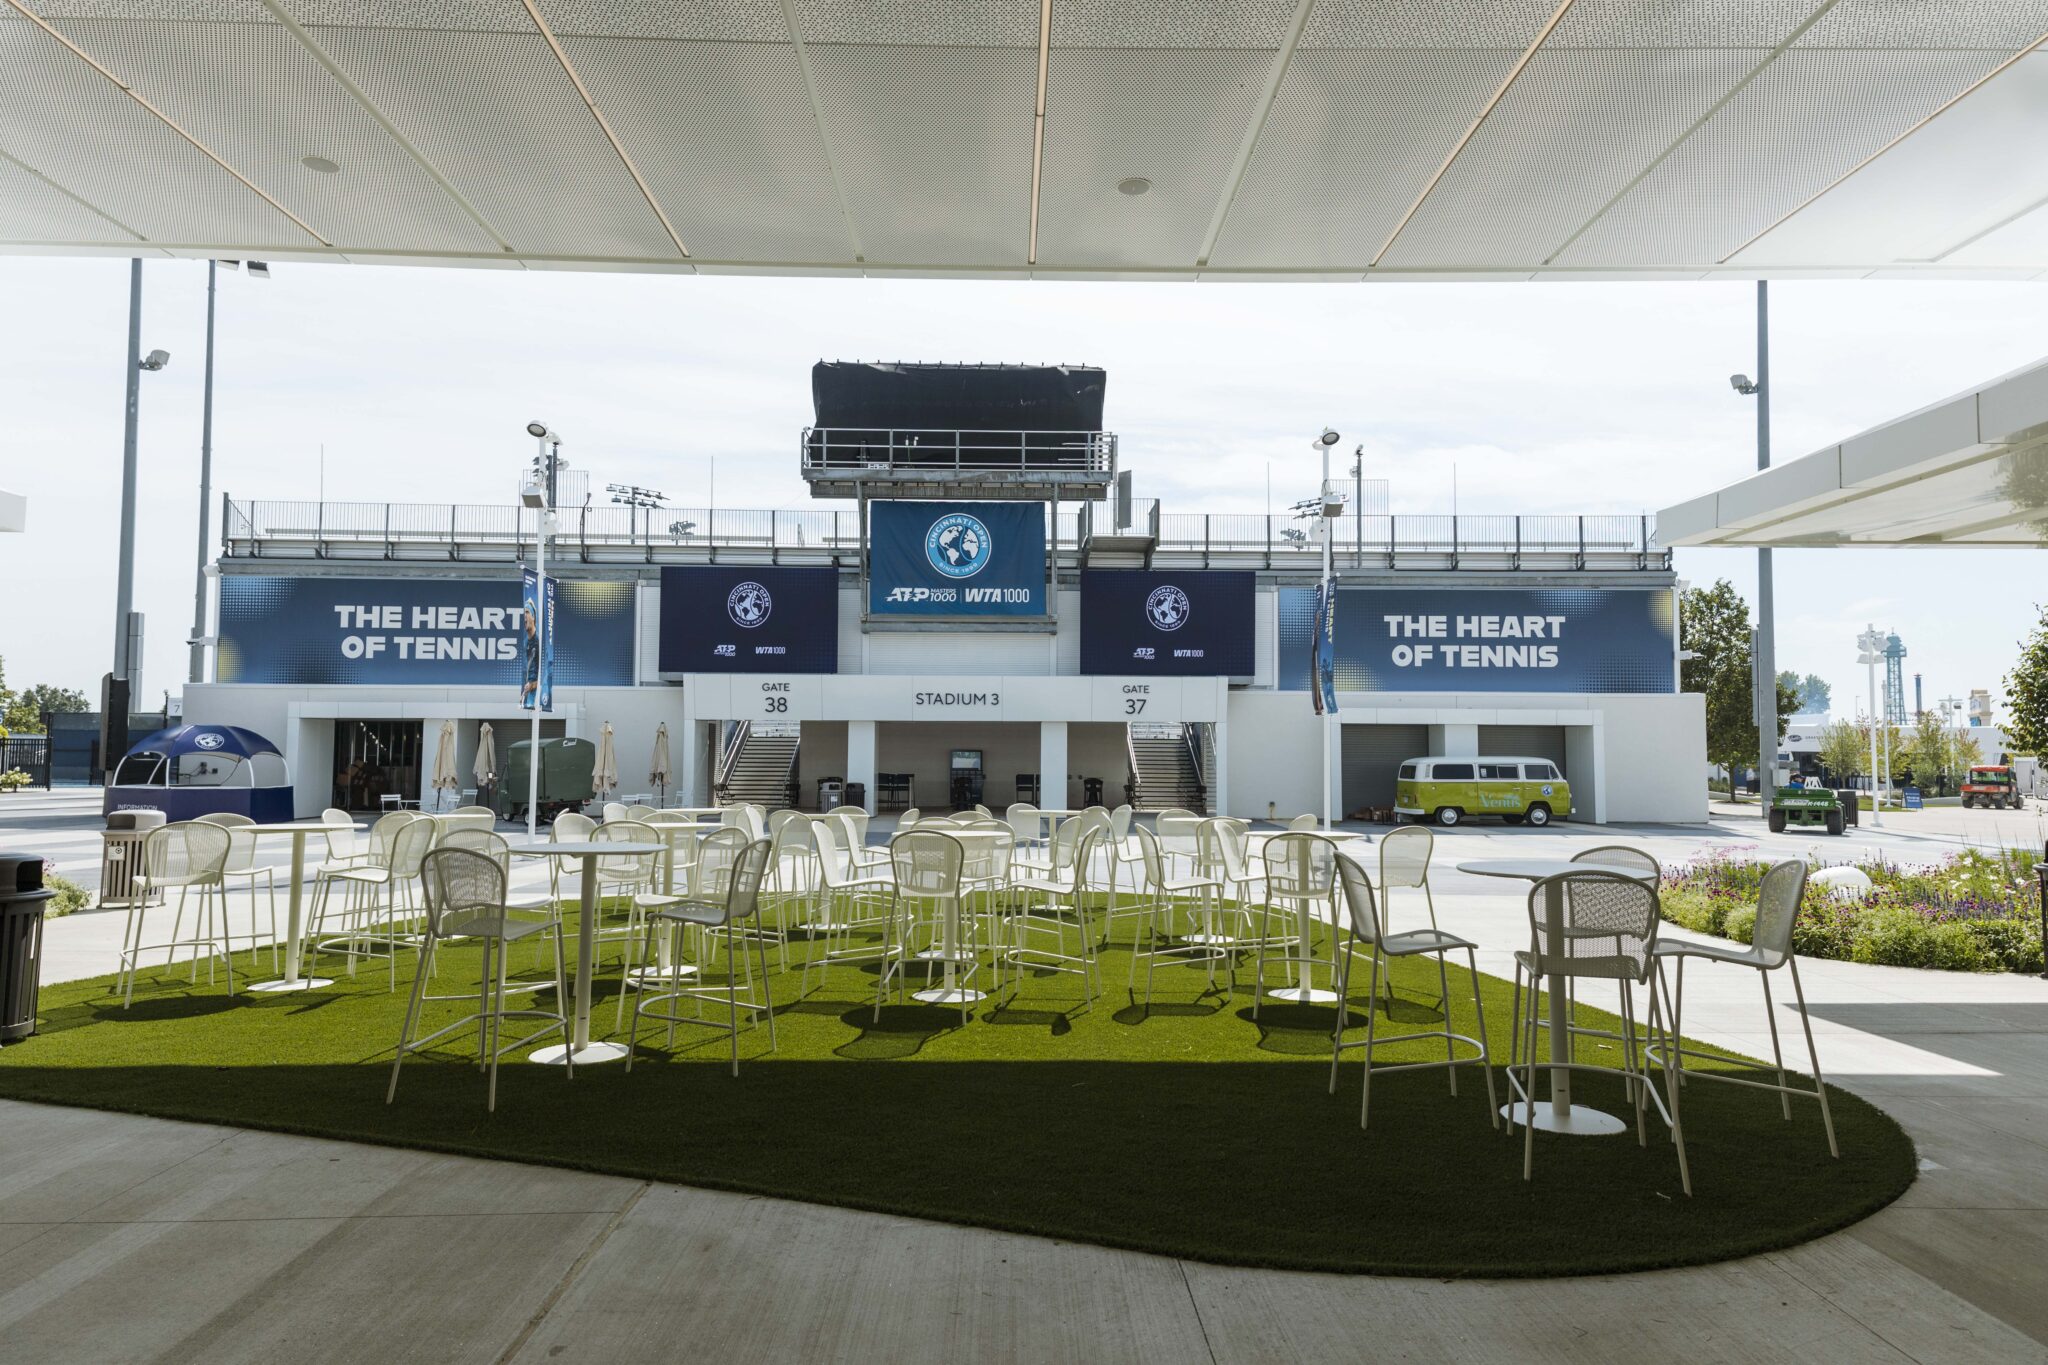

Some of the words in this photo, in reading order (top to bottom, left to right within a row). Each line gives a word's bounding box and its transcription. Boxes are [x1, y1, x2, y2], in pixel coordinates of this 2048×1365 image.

[929, 517, 972, 548] CINCINNATI
[973, 524, 988, 548] OPEN
[939, 562, 960, 574] SINCE
[961, 562, 978, 574] 1899
[729, 584, 759, 607] CINCINNATI
[759, 589, 769, 607] OPEN
[885, 587, 930, 602] ATP
[930, 593, 957, 602] 1000
[965, 588, 1002, 603] WTA
[1003, 588, 1030, 603] 1000
[1148, 587, 1177, 610] CINCINNATI
[1177, 592, 1187, 610] OPEN
[335, 605, 402, 629] THE
[411, 606, 525, 630] HEART
[1384, 615, 1447, 638] THE
[1457, 616, 1566, 638] HEART
[341, 635, 386, 659] OF
[394, 636, 518, 660] TENNIS
[714, 644, 736, 653] ATP
[755, 646, 773, 654] WTA
[773, 646, 786, 654] 1000
[1133, 647, 1155, 656] ATP
[1173, 649, 1191, 657] WTA
[1191, 649, 1204, 657] 1000
[1391, 644, 1433, 668] OF
[1440, 645, 1559, 668] TENNIS
[762, 683, 791, 692] GATE
[1122, 685, 1150, 694] GATE
[765, 697, 788, 713] 38
[915, 693, 987, 705] STADIUM
[990, 693, 1000, 706] 3
[1125, 699, 1147, 714] 37
[173, 704, 180, 713] 7
